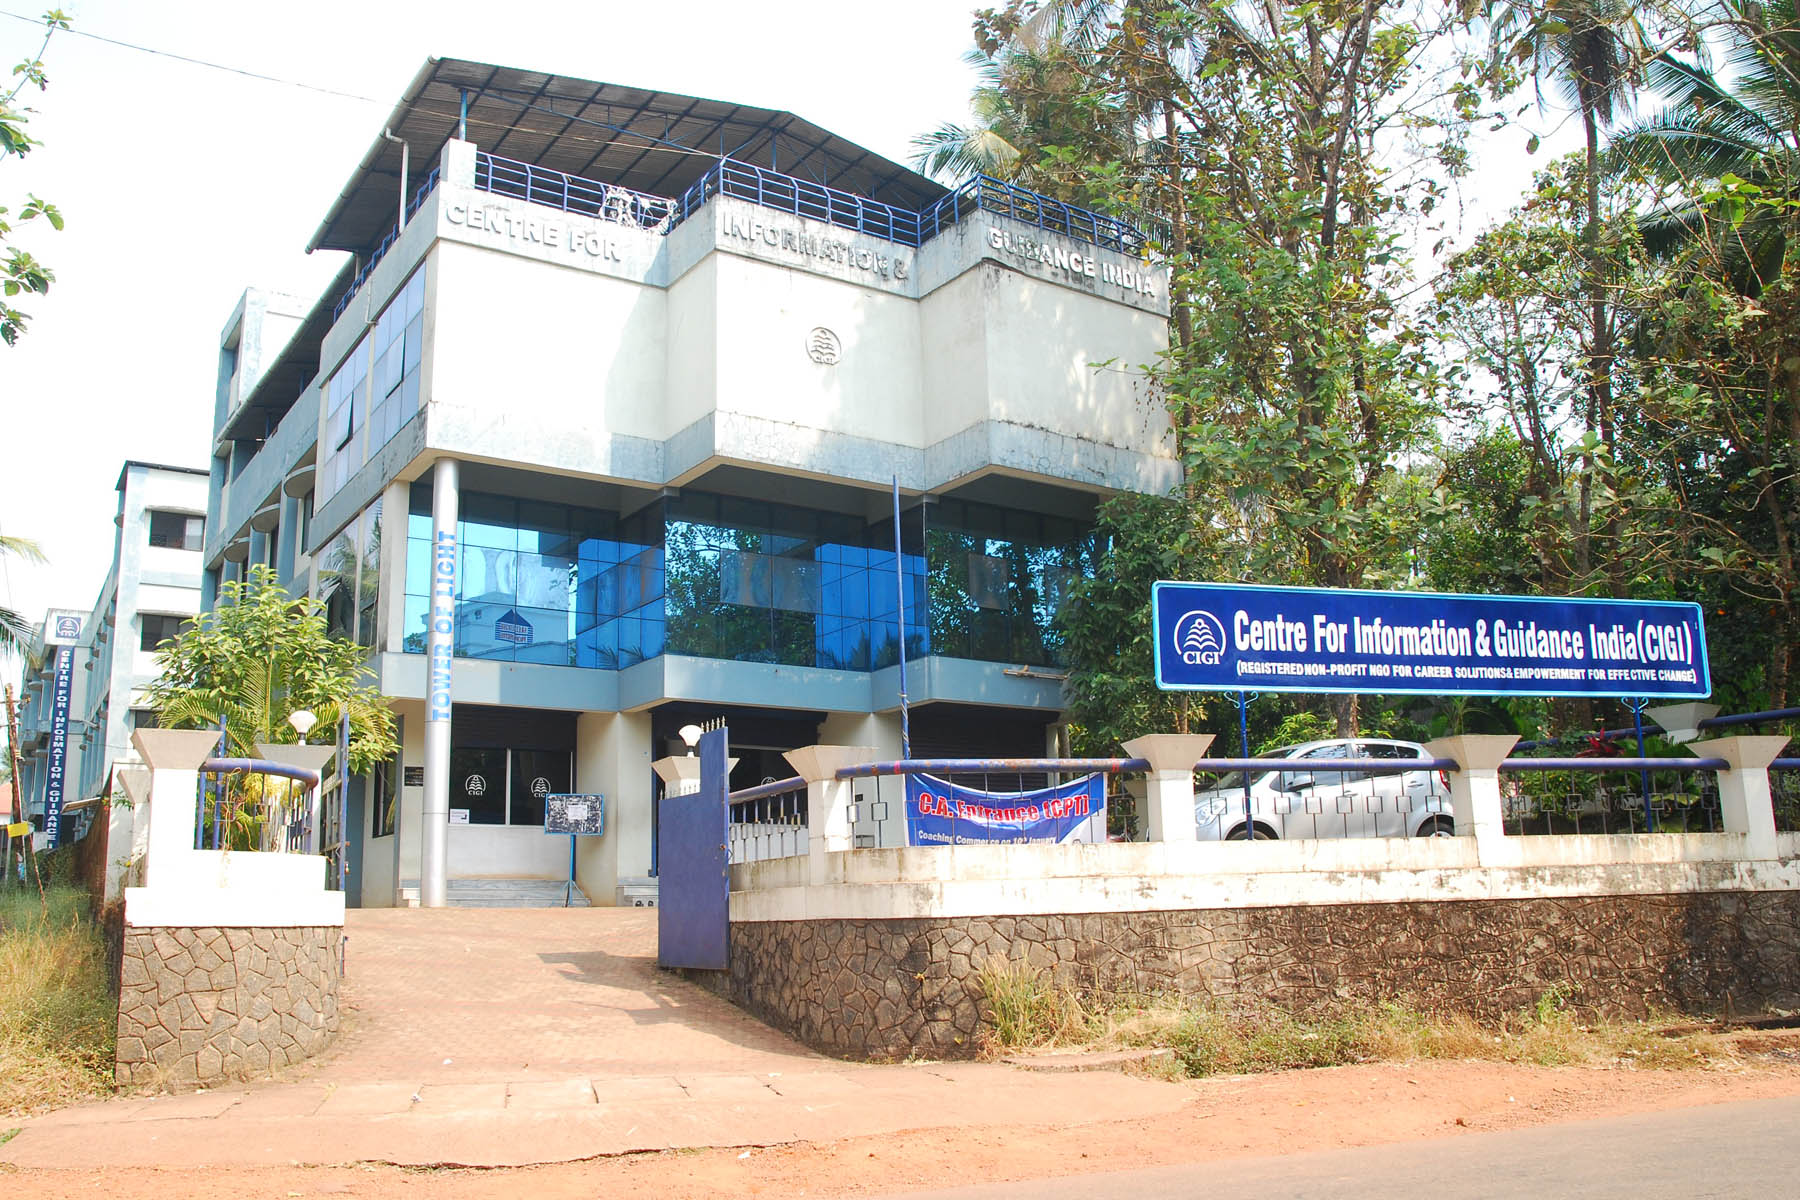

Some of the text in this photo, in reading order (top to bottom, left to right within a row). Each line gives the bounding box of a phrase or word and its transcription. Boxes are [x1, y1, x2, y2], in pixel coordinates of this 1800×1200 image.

[446, 203, 621, 263] CENTRE FOR
[723, 212, 909, 280] INFORMATION &
[988, 227, 1156, 297] GUIDANCE INDIA
[431, 531, 456, 721] TOWER OF LIGHT
[1233, 609, 1307, 652] Centre
[1313, 614, 1348, 654] For
[1353, 616, 1472, 657] Information
[1475, 618, 1492, 657] &
[1494, 619, 1585, 660] Guidance
[59, 650, 71, 687] CENTRE
[1183, 651, 1221, 665] CIGI
[1237, 660, 1304, 676] (REGISTERED
[1304, 663, 1367, 676] NON-PROFIT
[1369, 664, 1390, 676] NGO
[1392, 665, 1412, 677] FOR
[1414, 665, 1453, 678] CAREER
[1514, 667, 1586, 680] EMPOWERMENT
[1588, 668, 1606, 680] FOR
[1658, 669, 1697, 684] CHANGE)
[56, 689, 69, 708] FOR
[51, 710, 66, 779] INFORMATION
[46, 790, 60, 841] GUIDANCE
[919, 792, 954, 817] C.A.
[956, 799, 1039, 822] Entrance
[919, 830, 954, 844] Coaching
